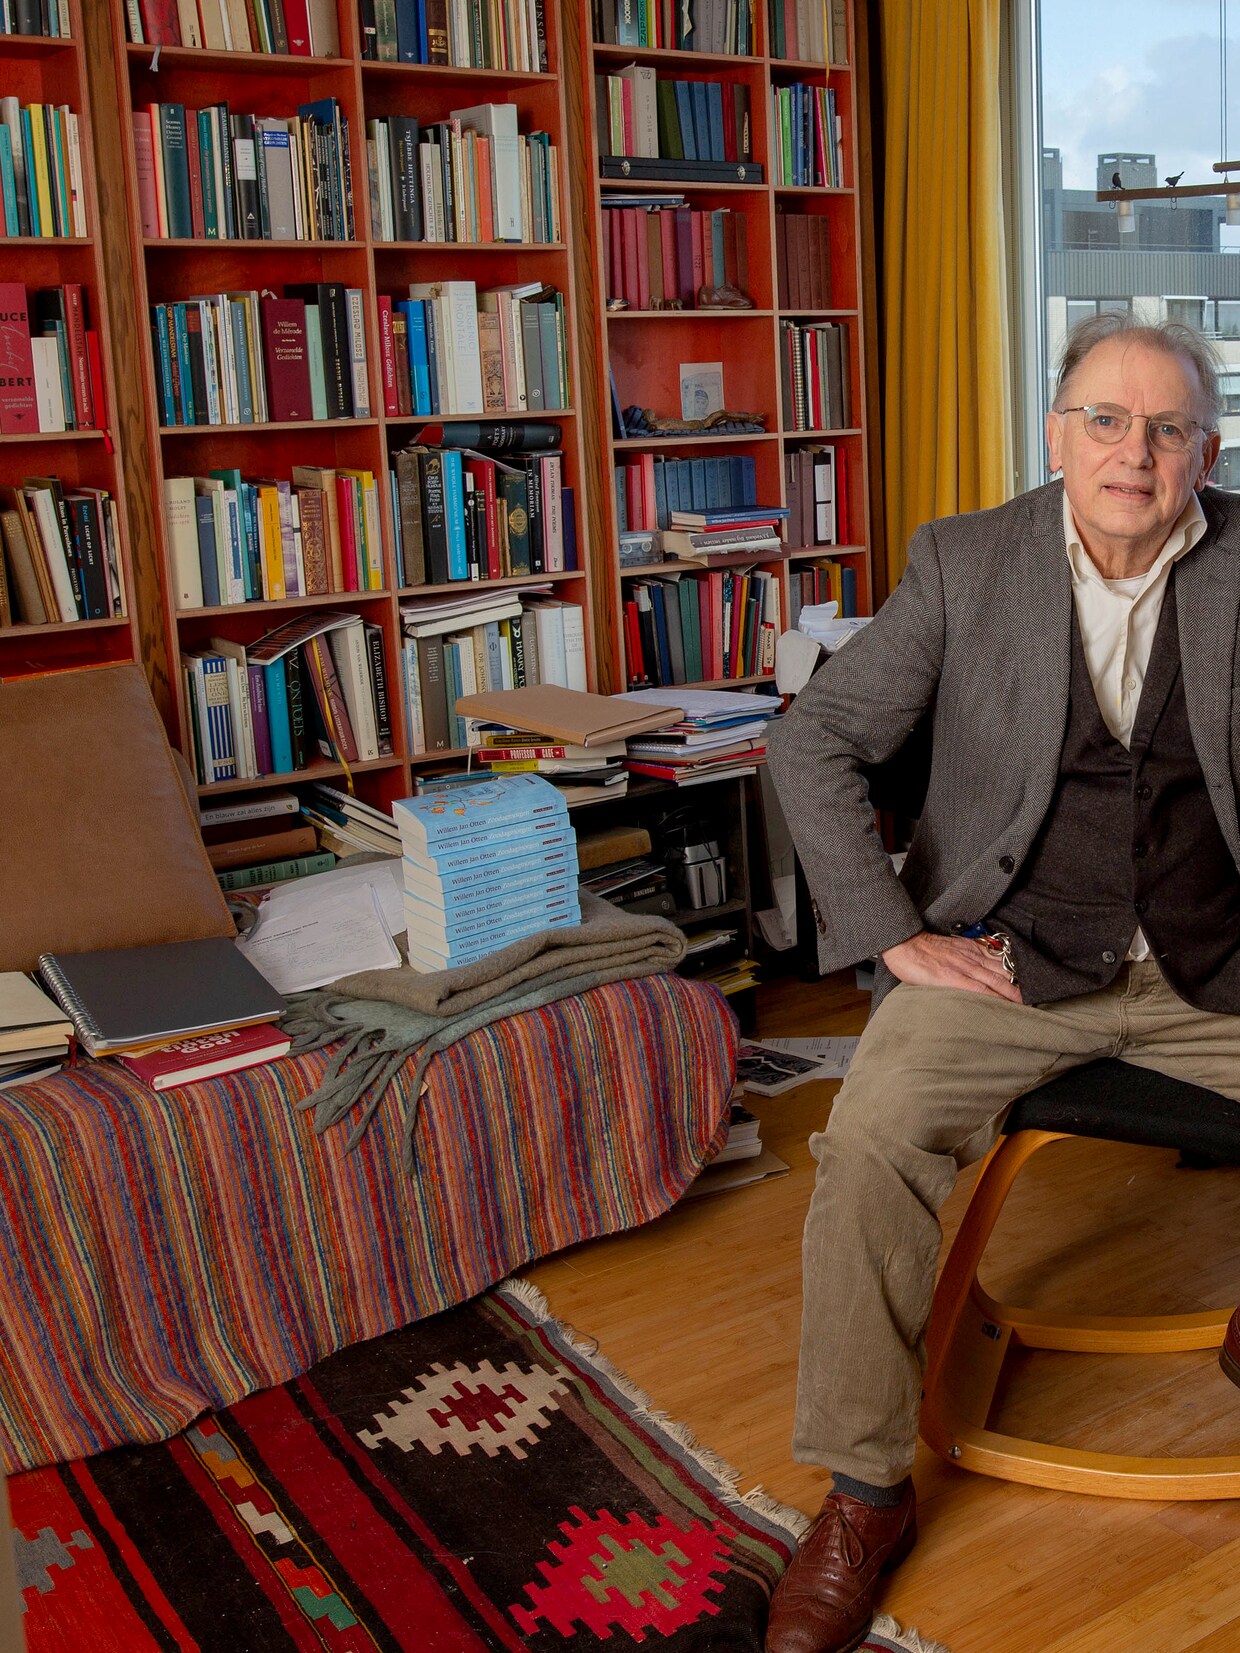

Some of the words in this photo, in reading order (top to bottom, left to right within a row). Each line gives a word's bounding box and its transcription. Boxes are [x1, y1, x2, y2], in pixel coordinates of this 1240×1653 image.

[407, 164, 416, 204] HETTINGA
[72, 307, 83, 356] MANDELSTAM
[168, 321, 176, 358] MANDELSTAM
[455, 304, 465, 352] MONTALE
[465, 304, 476, 350] EUGENIO
[0, 377, 32, 387] BERT
[386, 358, 394, 388] Gedichten
[528, 469, 533, 477] IN
[62, 525, 73, 557] Parentheses
[86, 541, 92, 549] OP
[288, 648, 299, 671] PAZ
[372, 641, 386, 689] ELIZABETH
[478, 652, 485, 664] DR
[516, 641, 524, 671] HARRY
[528, 631, 537, 675] AUGUSTINE
[478, 665, 486, 693] JOHNSO
[292, 704, 305, 737] POETS
[377, 691, 387, 722] BISHOP
[215, 811, 235, 820] blauw
[263, 805, 276, 813] zijn
[437, 825, 458, 835] Willem
[469, 819, 486, 827] Otten
[487, 809, 530, 824] Zondagmorgen
[438, 840, 460, 850] Willem
[461, 838, 470, 846] Jan
[471, 835, 488, 843] Otten
[489, 825, 532, 840] Zondagmorgen
[448, 857, 469, 867] Willem
[469, 855, 479, 863] Jan
[480, 851, 496, 860] Otten
[497, 841, 540, 857] Zondagmorgen
[451, 874, 472, 886] Willem
[473, 872, 482, 880] Jan
[483, 868, 500, 877] Otten
[500, 858, 542, 872] Zondagmorgen
[454, 891, 475, 902] Willem
[475, 889, 484, 897] Jan
[485, 885, 502, 894] Otten
[502, 874, 544, 890] Zondagmorgen
[455, 908, 476, 918] Willem
[476, 905, 485, 913] Jan
[486, 901, 502, 911] Otten
[503, 890, 543, 906] Zondagmorgen
[455, 924, 476, 934] Willem
[476, 921, 486, 930] Jan
[486, 917, 502, 926] Otten
[503, 905, 543, 922] Zondagmorgen
[459, 938, 480, 949] Willem
[480, 936, 489, 944] Jan
[490, 932, 506, 941] Otten
[506, 921, 547, 936] Zondagmorgen
[456, 955, 477, 965] Willem
[179, 1037, 233, 1054] God
